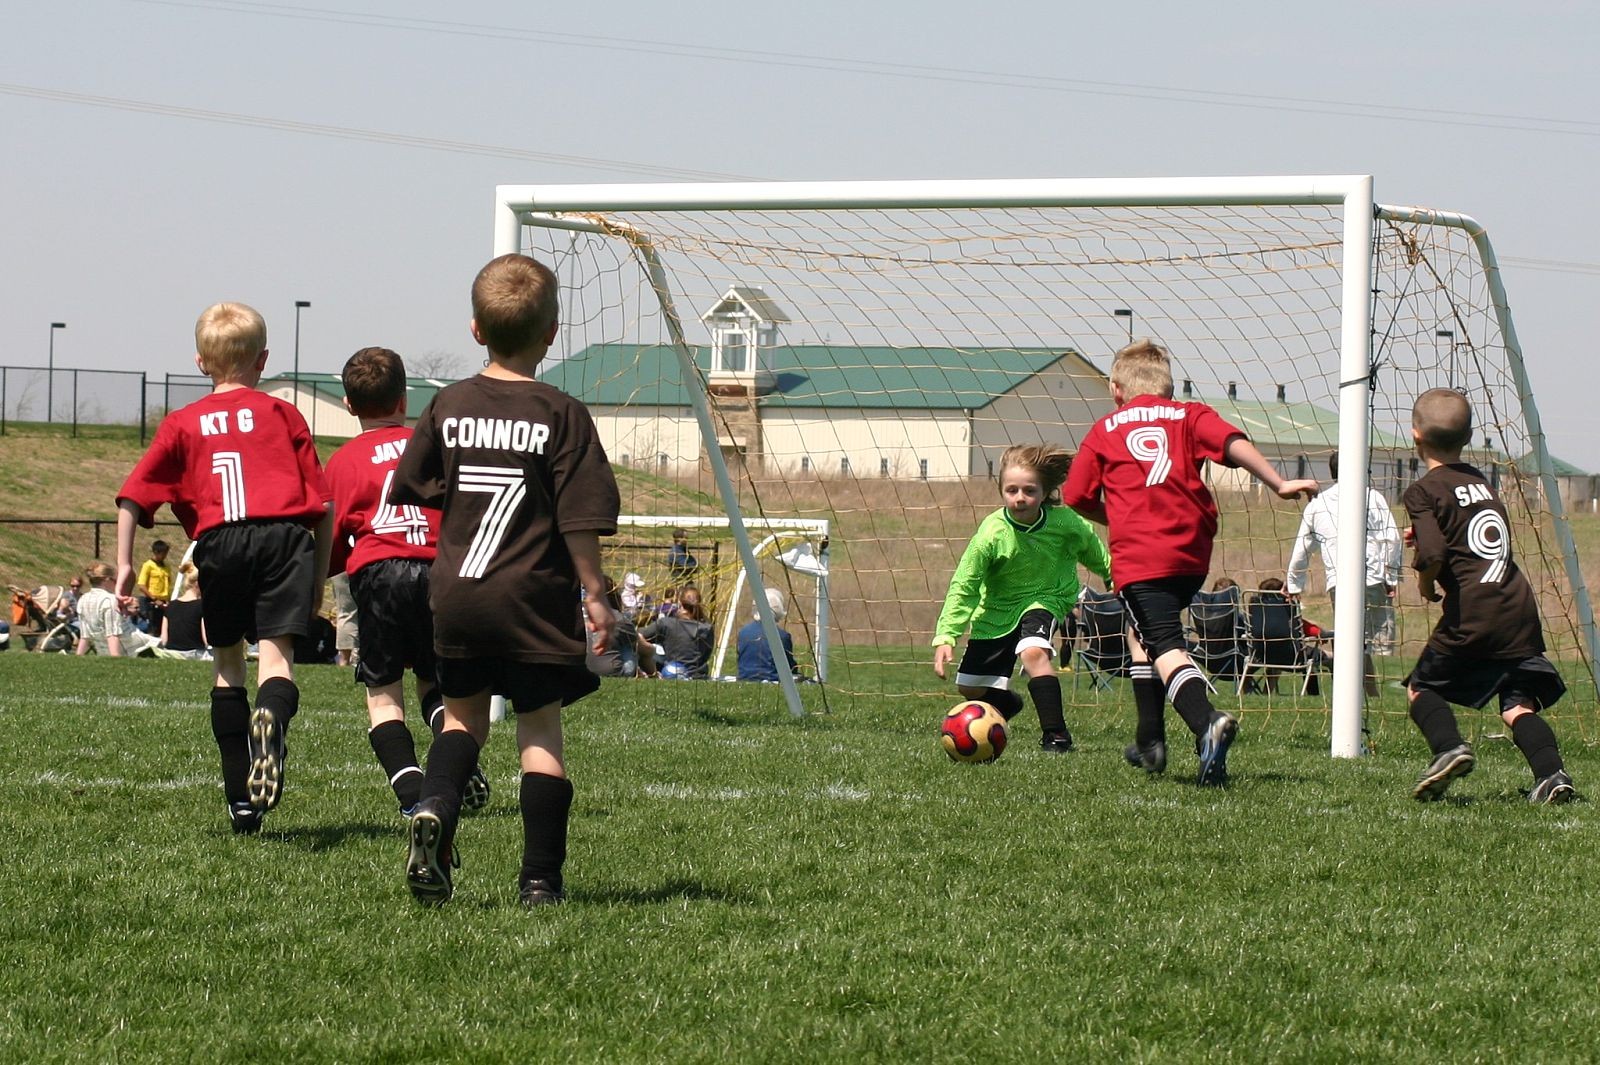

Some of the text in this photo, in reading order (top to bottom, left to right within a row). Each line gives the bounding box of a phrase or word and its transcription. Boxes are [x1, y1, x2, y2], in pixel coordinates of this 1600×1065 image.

[200, 408, 254, 436] KT G
[442, 417, 550, 455] CONNOR
[1105, 405, 1186, 432] LIGHTNING
[212, 451, 246, 522] 1
[1126, 426, 1172, 487] 9
[371, 469, 429, 546] 4
[458, 465, 527, 578] 7
[1467, 508, 1511, 583] 9
